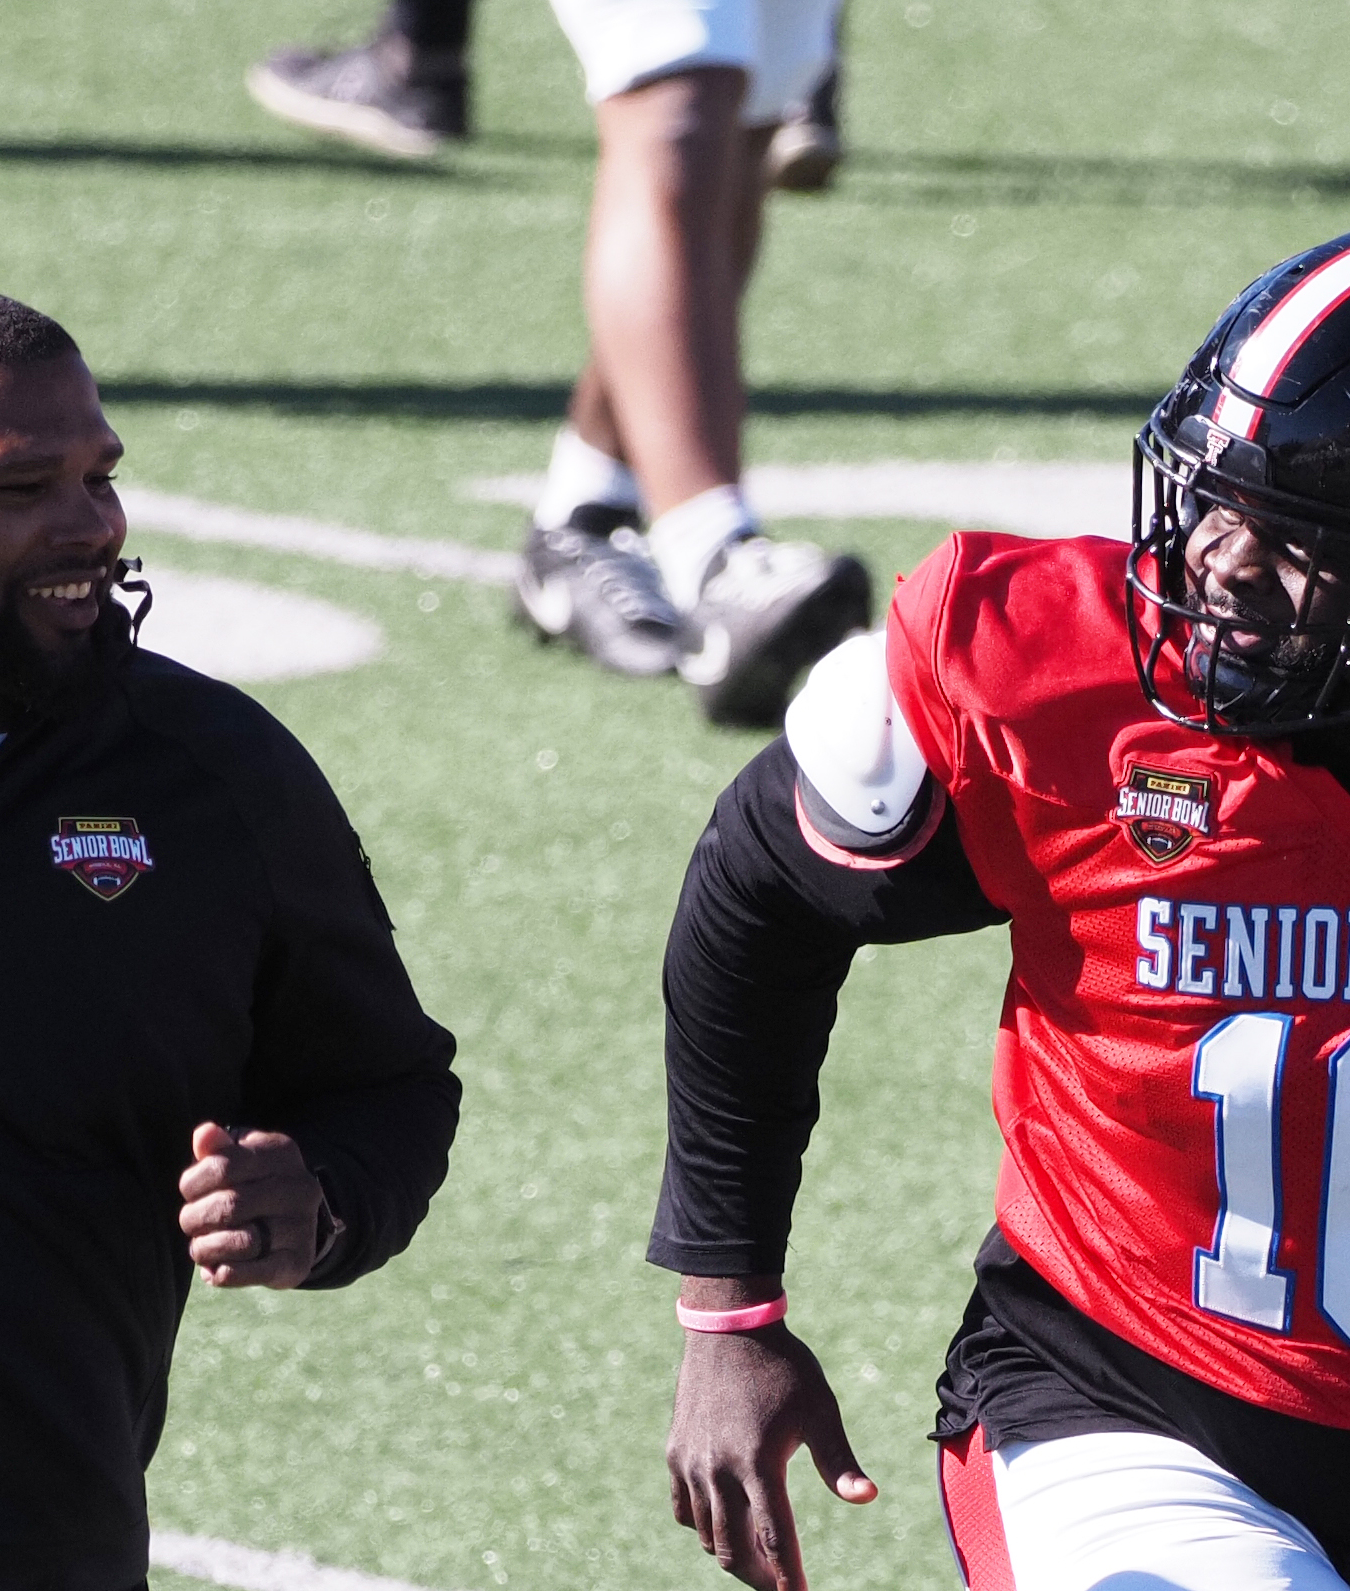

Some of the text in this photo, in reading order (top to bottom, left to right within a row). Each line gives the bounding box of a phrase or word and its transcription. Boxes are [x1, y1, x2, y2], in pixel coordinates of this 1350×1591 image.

[1150, 780, 1188, 793] PANINI
[1116, 787, 1210, 834] SENIOR BOWL
[78, 822, 119, 830] PANINI
[51, 834, 154, 867] SENIOR BOWL
